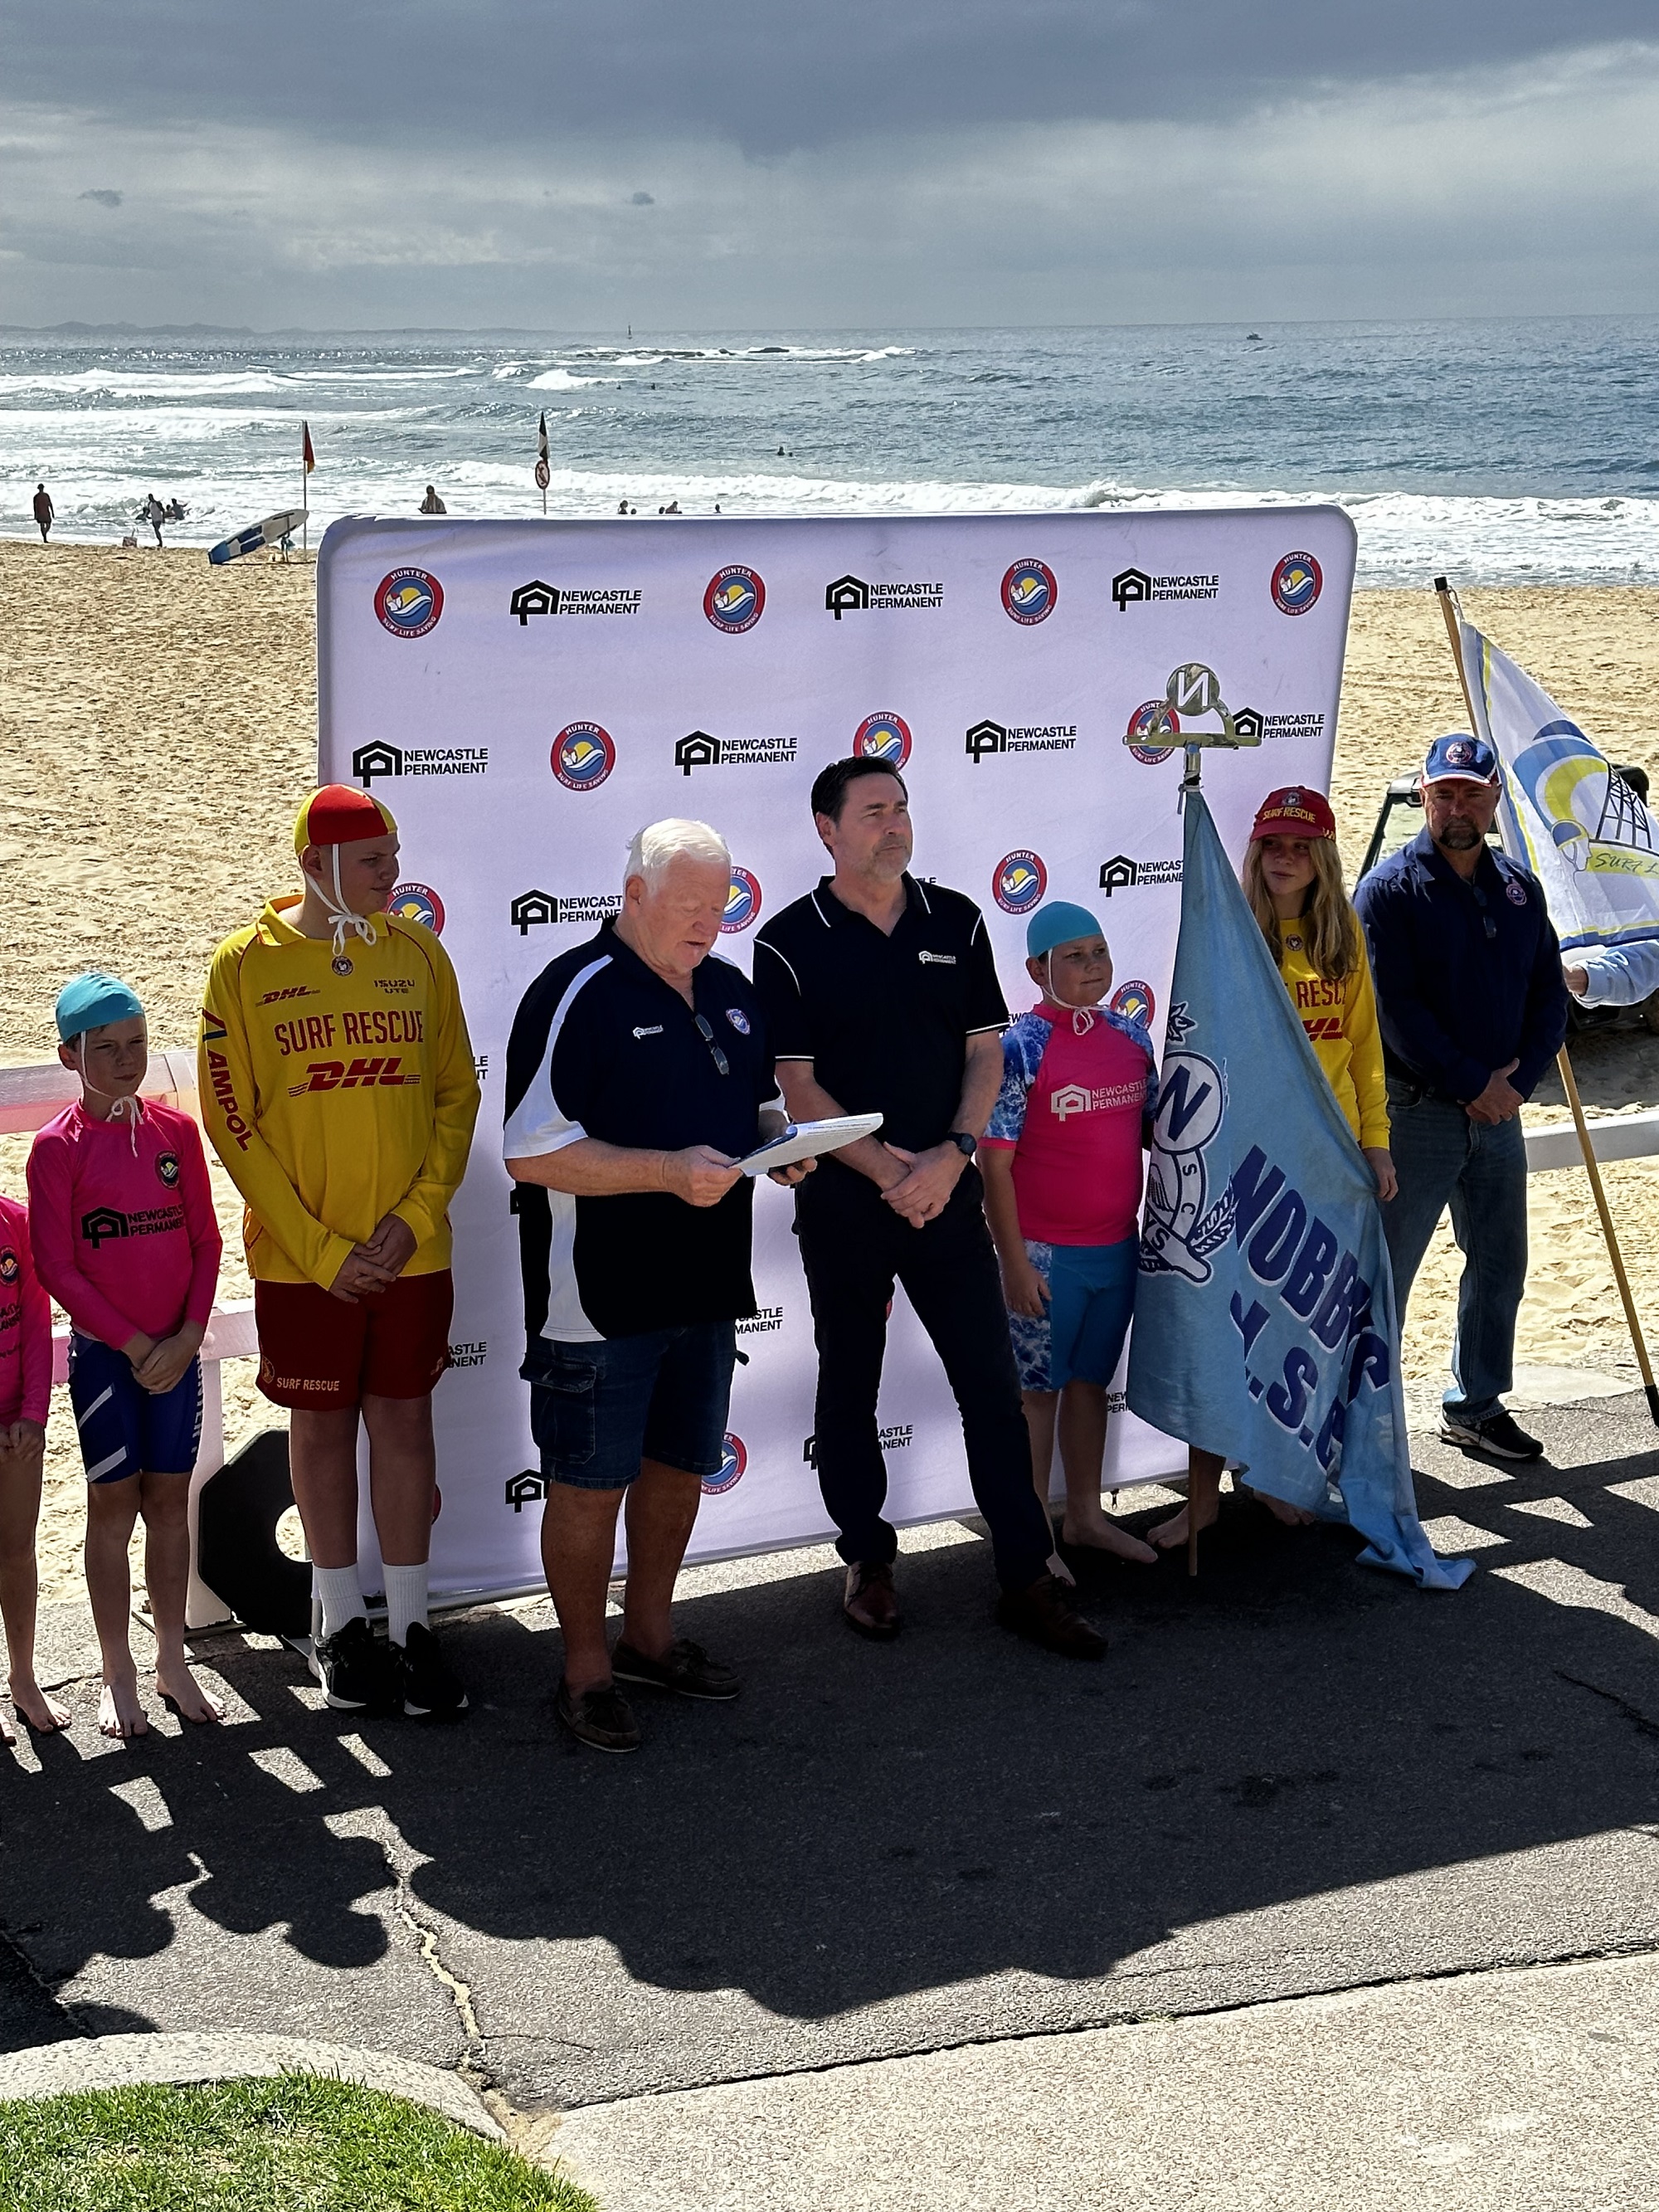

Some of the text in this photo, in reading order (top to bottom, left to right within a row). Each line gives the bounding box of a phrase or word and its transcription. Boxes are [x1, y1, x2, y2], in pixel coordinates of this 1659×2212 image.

[1283, 553, 1311, 563] HUNTER
[1014, 560, 1044, 571] HUNTER
[390, 569, 428, 580] HUNTER
[719, 568, 752, 578] HUNTER
[1152, 575, 1219, 587] NEWCASTLE
[561, 590, 642, 602] NEWCASTLE
[870, 583, 943, 596] NEWCASTLE
[1152, 588, 1219, 601] PERMANENT
[559, 603, 640, 615] PERMANENT
[870, 597, 943, 609] PERMANENT
[867, 714, 898, 724] HUNTER
[1264, 714, 1325, 727] NEWCASTLE
[565, 724, 600, 735] HUNTER
[1008, 725, 1077, 739] NEWCASTLE
[1263, 727, 1323, 738] PERMANENT
[722, 738, 797, 751] NEWCASTLE
[1007, 738, 1076, 752] PERMANENT
[404, 748, 488, 762] NEWCASTLE
[721, 751, 797, 764] PERMANENT
[404, 763, 488, 776] PERMANENT
[1283, 806, 1316, 823] RESCUE
[1005, 852, 1035, 862] HUNTER
[1138, 860, 1184, 873] NEWCAS
[1137, 872, 1184, 885] PERMANE
[392, 884, 428, 897] HUNTER
[560, 895, 623, 909] NEWCAST
[560, 909, 621, 923] PERMANE
[374, 979, 415, 987] ISUZU
[263, 986, 312, 1004] DHL
[1296, 979, 1347, 1009] RESC
[275, 1010, 424, 1056] SURF RESCUE
[1302, 1017, 1344, 1042] HL
[306, 1056, 406, 1093] DHL
[207, 1049, 253, 1152] AMPOL
[1155, 1064, 1213, 1143] N
[735, 1319, 783, 1334] MANENT
[448, 1341, 487, 1355] ASTLE
[276, 1377, 340, 1391] SURF RESCUE
[879, 1424, 913, 1438] ASTLE
